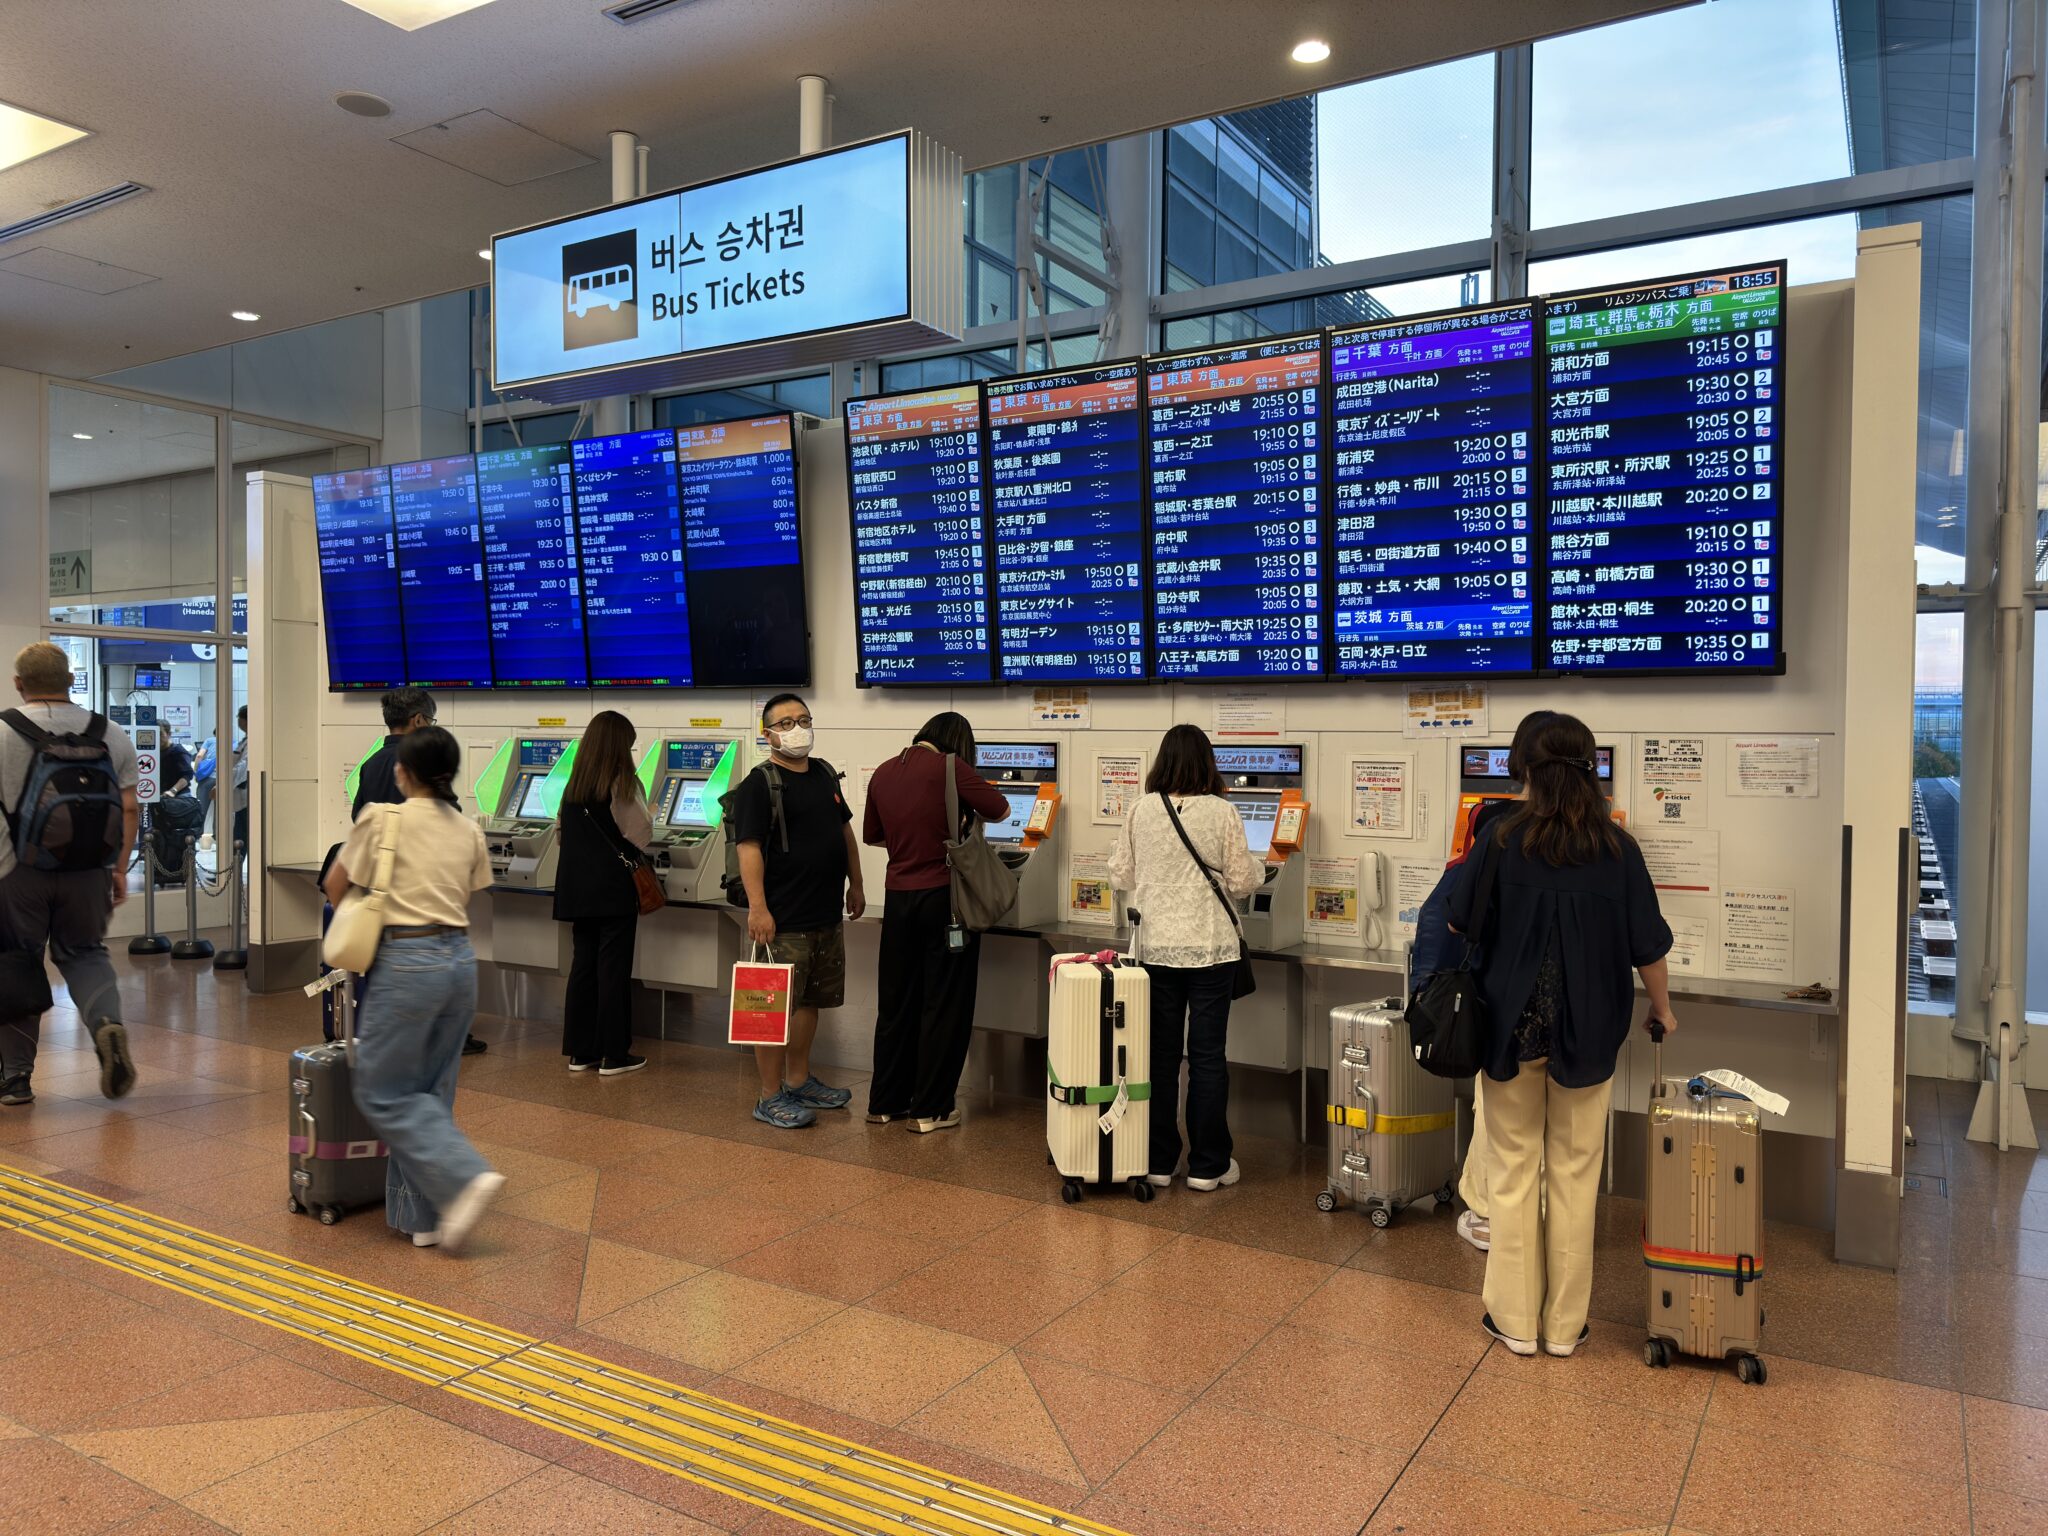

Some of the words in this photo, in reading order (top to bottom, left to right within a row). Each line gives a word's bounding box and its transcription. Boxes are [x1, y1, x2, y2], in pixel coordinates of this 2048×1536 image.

[651, 231, 704, 274] 버스
[716, 204, 805, 262] 승차권
[652, 288, 698, 321] Bus
[705, 267, 805, 311] Tickets
[1605, 286, 1692, 306] リムジンバスご乗
[1734, 273, 1772, 288] 18:55
[1687, 300, 1712, 313] 方面
[1753, 308, 1776, 318] のりば
[1353, 344, 1382, 360] 千葉
[1389, 341, 1413, 355] 方面
[1551, 342, 1575, 353] 行き先
[1551, 352, 1609, 373] 浦和方面
[1687, 338, 1730, 354] 19:15
[1552, 371, 1591, 383] 浦和方面
[1697, 354, 1730, 367] 20:45
[1167, 370, 1192, 386] 東京
[1199, 369, 1219, 380] 方面
[1551, 388, 1609, 407] 大宮方面
[1687, 376, 1729, 392] 19:30
[1252, 394, 1284, 408] 20:55
[1338, 397, 1372, 410] 成田机场
[1697, 392, 1730, 405] 20:30
[1260, 408, 1284, 420] 21:55
[1253, 427, 1284, 440] 19:10
[1551, 425, 1610, 443] 和光市駅
[1686, 414, 1728, 429] 19:05
[657, 438, 673, 447] 18:55
[930, 437, 953, 448] 19:10
[1261, 442, 1284, 451] 19:55
[1553, 443, 1592, 455] 和光市站
[1696, 430, 1729, 442] 20:05
[763, 453, 785, 464] 1,000
[1337, 450, 1374, 466] 新浦安
[1454, 438, 1490, 452] 19:20
[1462, 453, 1490, 464] 20:00
[1686, 450, 1728, 466] 19:25
[854, 471, 895, 484] 新宿駅西口
[931, 465, 954, 476] 19:10
[1154, 469, 1186, 483] 調布駅
[1254, 460, 1284, 472] 19:05
[1696, 467, 1728, 479] 20:25
[771, 477, 786, 486] 650
[1261, 474, 1285, 483] 19:15
[1453, 472, 1490, 486] 20:15
[995, 481, 1071, 499] 東京駅八重洲北口
[1462, 489, 1490, 498] 21:15
[1686, 488, 1728, 503] 20:20
[773, 499, 787, 508] 800
[856, 498, 897, 511] バスタ新宿
[932, 493, 956, 504] 19:10
[1254, 492, 1285, 505] 20:15
[997, 515, 1023, 527] 大手町
[1027, 513, 1046, 524] 方面
[1337, 516, 1374, 531] 津田沼
[1454, 507, 1490, 520] 19:30
[774, 522, 789, 531] 900
[857, 524, 916, 538] 新宿地区ホテル
[1339, 532, 1364, 541] 津田沼
[1462, 522, 1490, 532] 19:50
[1155, 531, 1187, 544] 府中駅
[1254, 524, 1285, 536] 19:05
[1551, 532, 1609, 549] 熊谷方面
[1686, 526, 1728, 540] 19:10
[1262, 537, 1286, 546] 19:35
[1454, 541, 1490, 555] 19:40
[641, 553, 659, 561] 19:30
[859, 552, 908, 565] 新宿歌舞伎町
[935, 549, 958, 559] 19:45
[1552, 550, 1591, 561] 熊谷方面
[1696, 541, 1728, 553] 20:15
[1156, 559, 1221, 574] 武蔵小金井駅
[1255, 556, 1286, 567] 19:35
[1686, 563, 1728, 577] 19:30
[1085, 567, 1111, 578] 19:50
[1263, 569, 1286, 578] 20:35
[936, 577, 960, 587] 20:10
[1092, 580, 1112, 588] 20:25
[1454, 576, 1490, 588] 19:05
[1696, 578, 1728, 589] 21:30
[1157, 591, 1200, 604] 国分寺駅
[1256, 588, 1286, 598] 19:05
[937, 604, 961, 614] 20:15
[1000, 597, 1074, 611] 東京ビッグサイト
[1263, 600, 1287, 609] 20:05
[1685, 600, 1727, 613] 20:20
[1355, 611, 1382, 624] 茨城
[1388, 611, 1412, 623] 方面
[1256, 619, 1287, 630] 19:25
[863, 632, 913, 643] 石神井公園駅
[939, 631, 962, 640] 19:05
[1001, 627, 1057, 639] 有明ガーデン
[1087, 625, 1113, 636] 19:15
[1264, 631, 1287, 640] 20:25
[1094, 638, 1114, 646] 19:45
[1686, 635, 1727, 649] 19:35
[1088, 654, 1114, 664] 19:15
[1257, 650, 1287, 660] 19:20
[1695, 650, 1727, 662] 20:50
[865, 658, 914, 669] 虎ノ門ヒルズ
[1095, 666, 1115, 674] 19:45
[1264, 662, 1288, 671] 21:00
